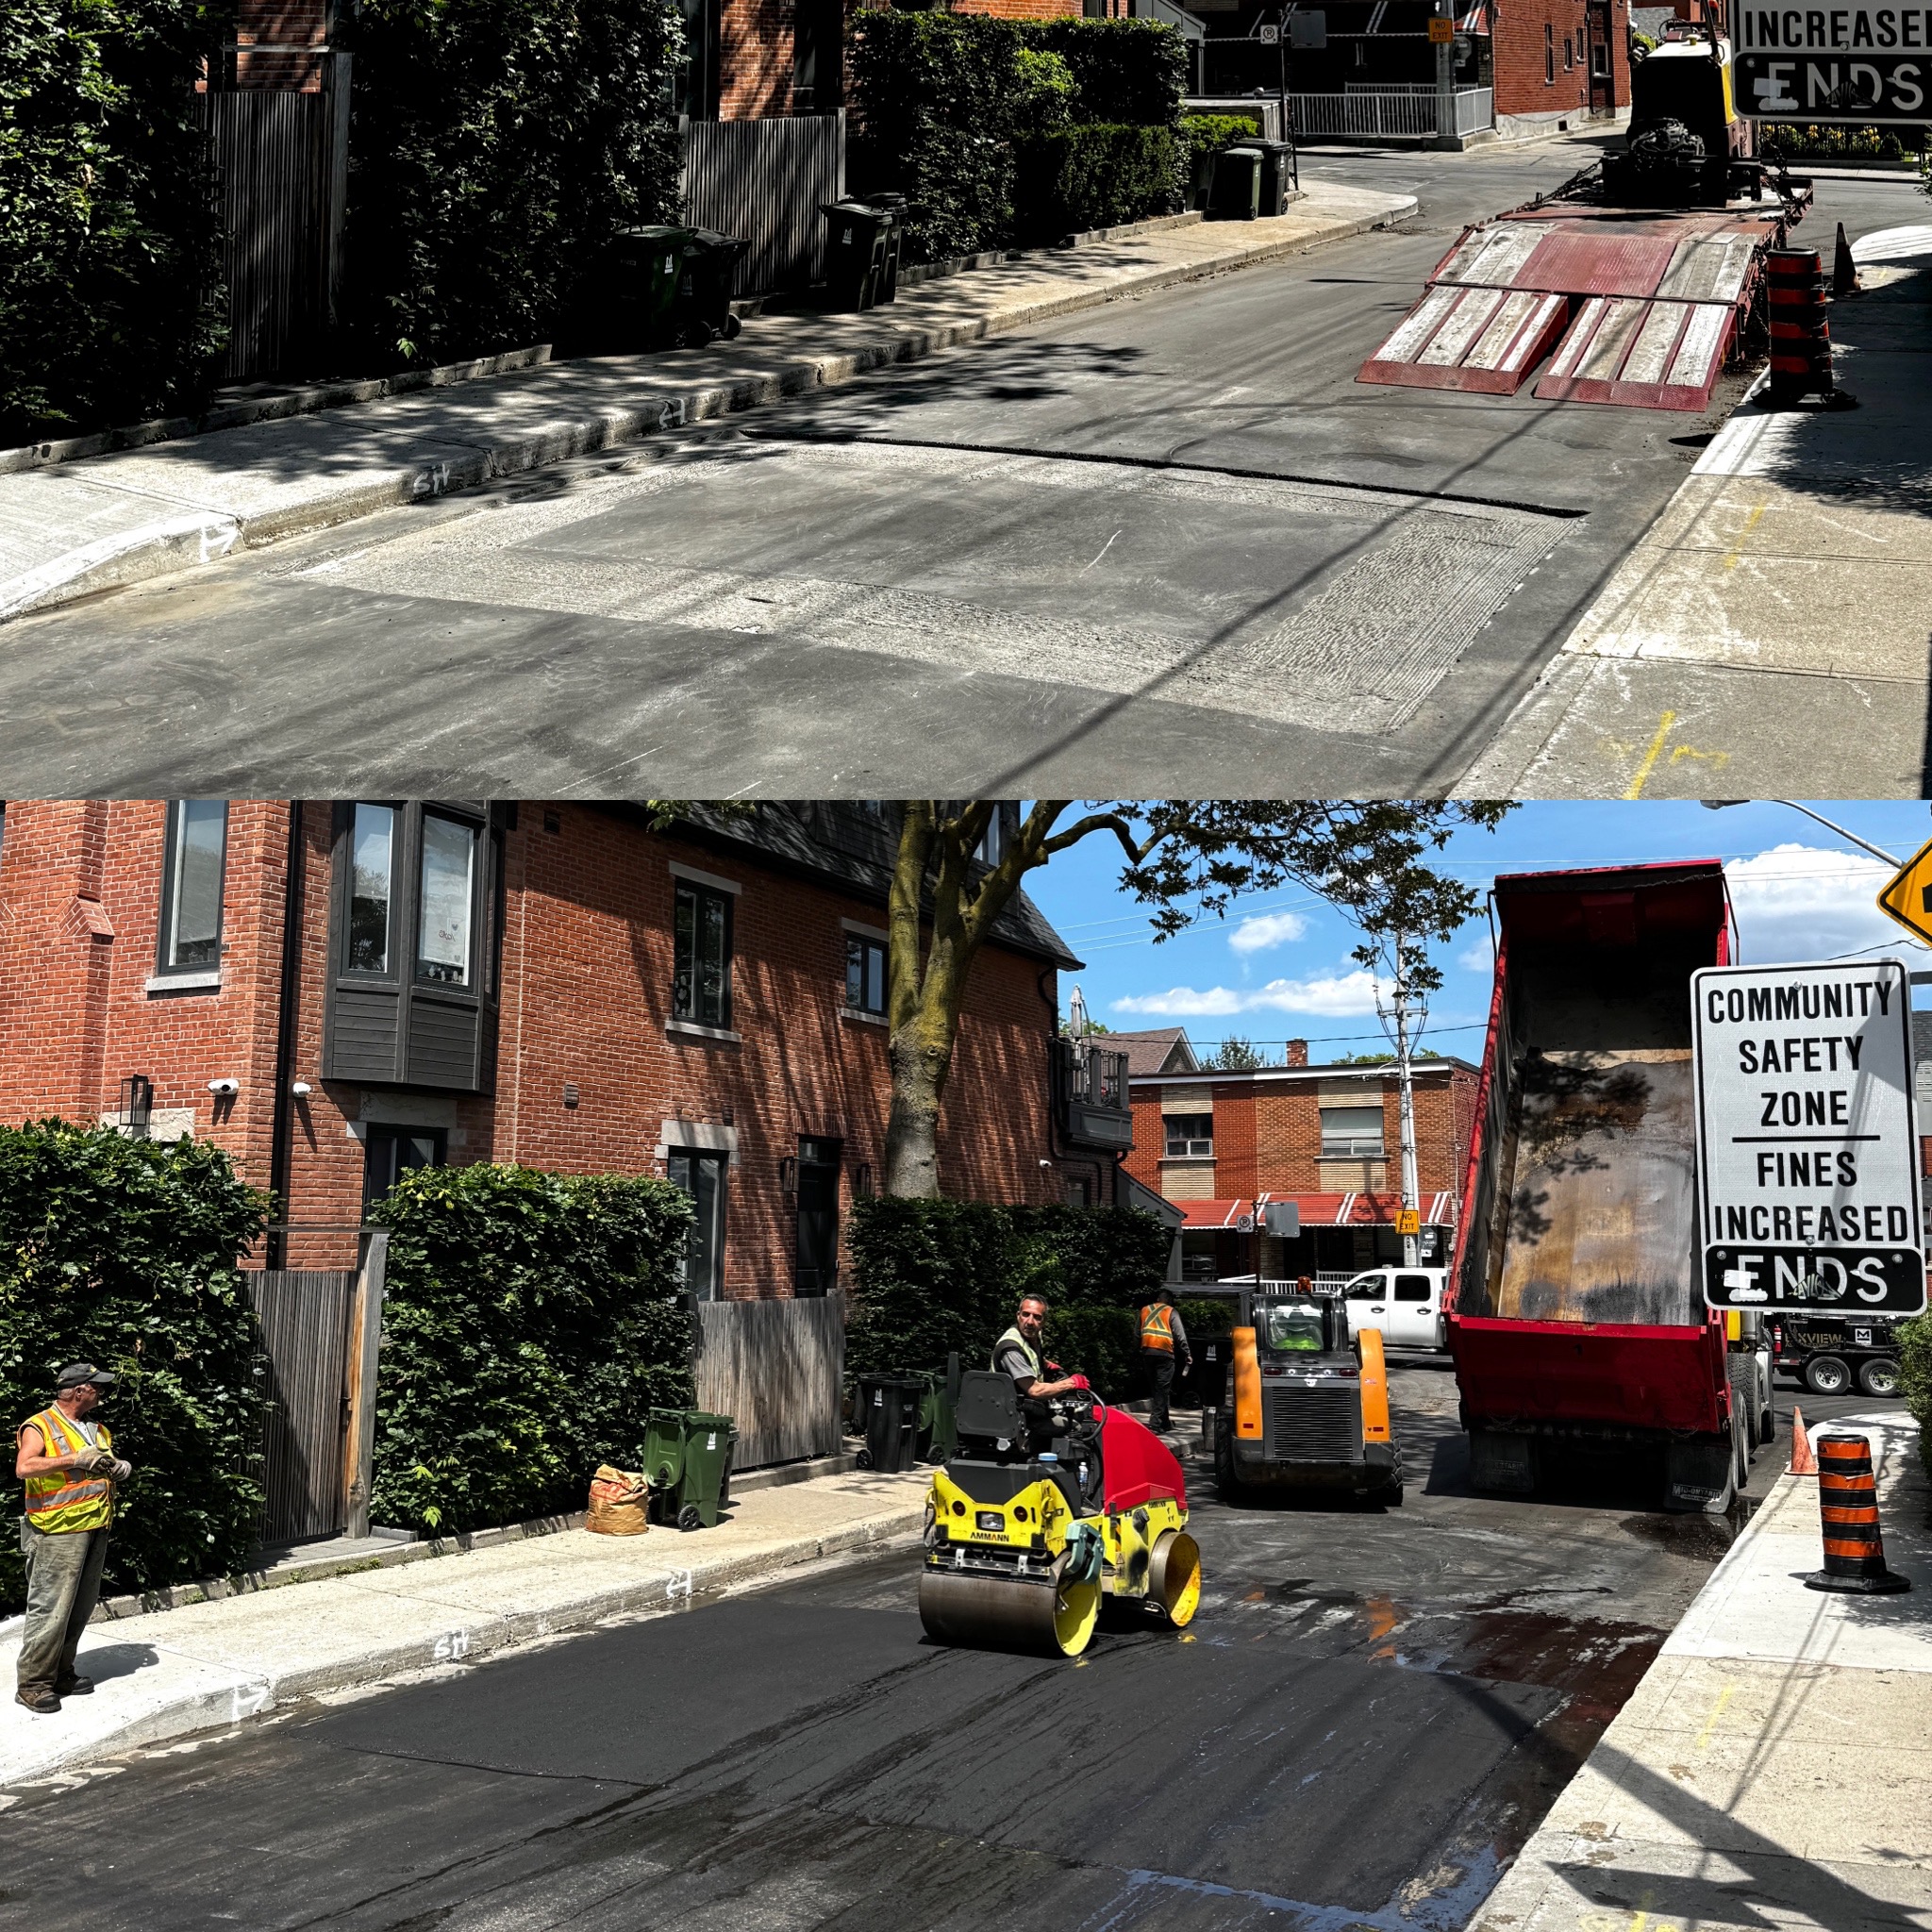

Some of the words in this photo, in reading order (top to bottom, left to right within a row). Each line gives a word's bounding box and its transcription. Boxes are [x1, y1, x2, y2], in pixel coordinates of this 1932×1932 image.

[1433, 31, 1449, 40] EXIT
[1435, 21, 1446, 29] NO
[1768, 62, 1924, 110] ENDS
[1707, 980, 1892, 1024] COMMUNITY
[1739, 1035, 1864, 1074] SAFETY
[1760, 1091, 1849, 1127] ZONE
[1757, 1151, 1857, 1188] FINES
[1714, 1205, 1908, 1241] INCREASED
[1737, 1255, 1888, 1303] ENDS
[970, 1531, 1009, 1542] AMMANN
